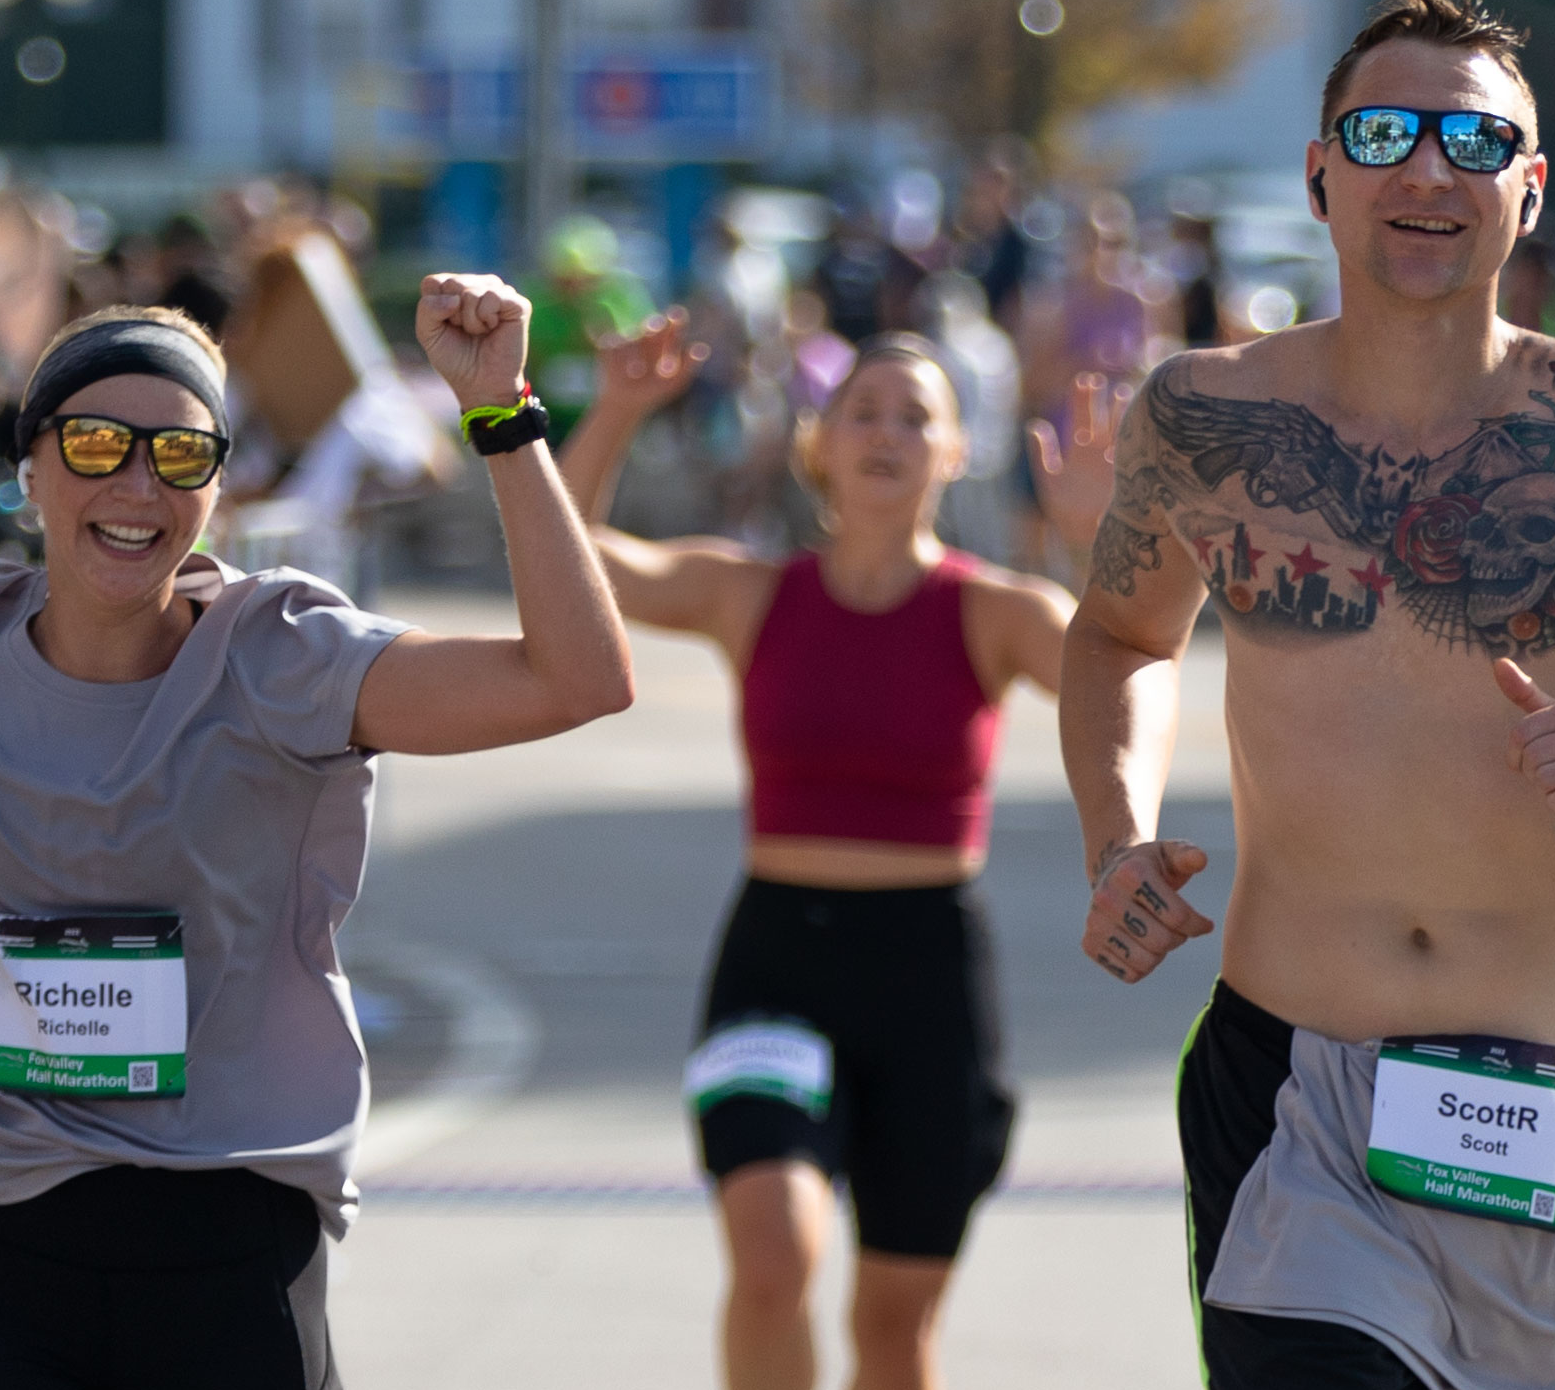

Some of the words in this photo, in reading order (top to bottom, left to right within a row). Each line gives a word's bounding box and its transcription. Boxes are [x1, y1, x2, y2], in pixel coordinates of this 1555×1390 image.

[14, 981, 133, 1008] Richelle
[37, 1018, 110, 1036] Richelle
[45, 1055, 84, 1072] Valley
[54, 1071, 128, 1089] Marathon
[1437, 1091, 1539, 1133] ScottR
[1459, 1133, 1509, 1157] Scott
[1426, 1163, 1449, 1179] Fox
[1451, 1168, 1491, 1189] Valley
[1424, 1178, 1456, 1198] Half
[1456, 1186, 1530, 1212] Marathon
